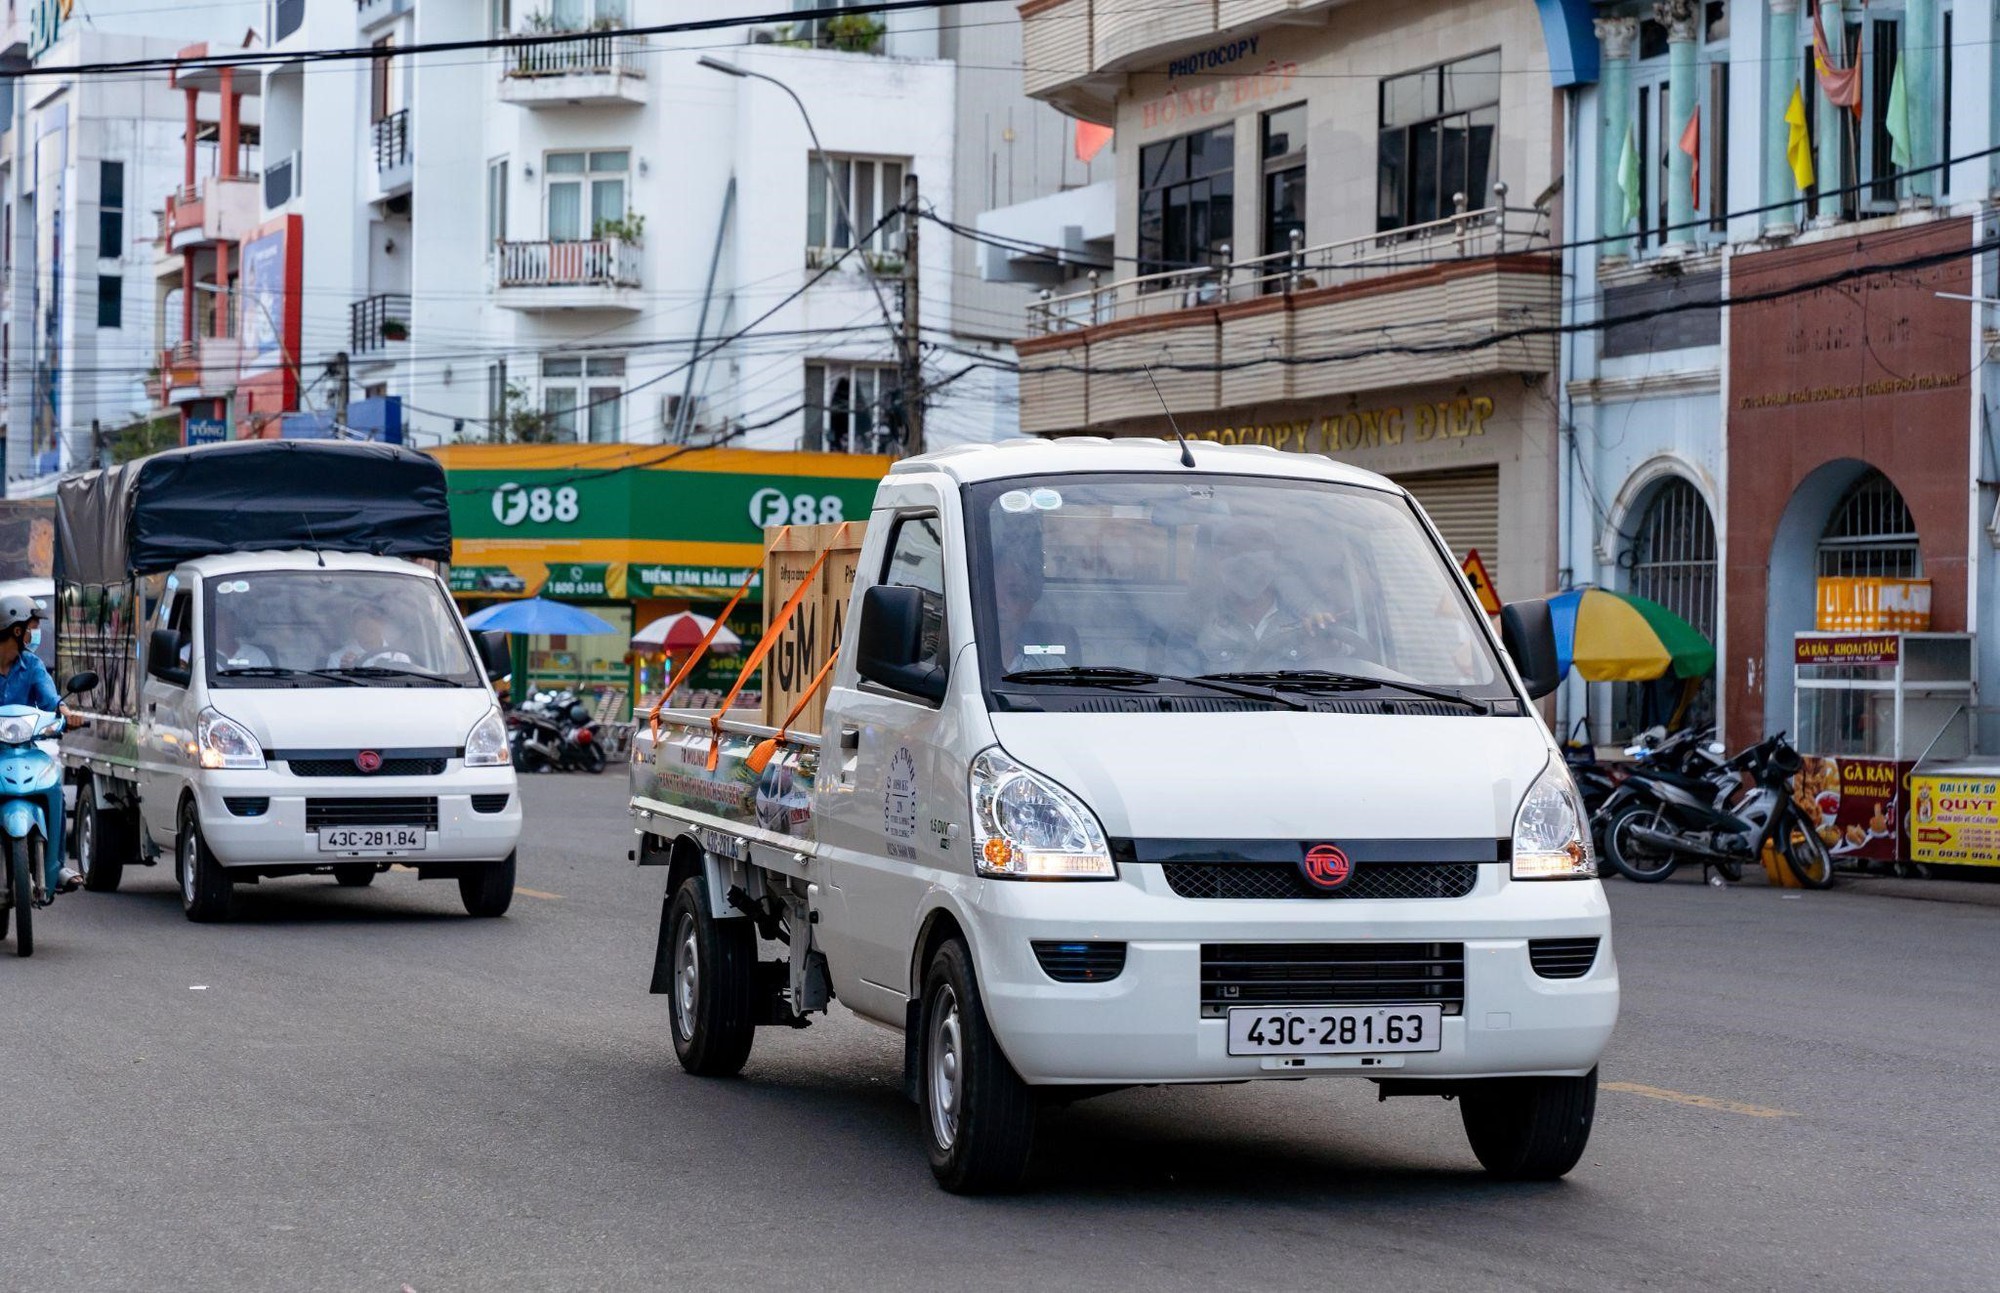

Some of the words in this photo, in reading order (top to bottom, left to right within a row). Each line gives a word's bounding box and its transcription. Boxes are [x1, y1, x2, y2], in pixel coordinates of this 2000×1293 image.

[1168, 36, 1260, 79] PHOTOCOPY
[492, 482, 579, 526] F88
[749, 487, 844, 530] F88
[1799, 641, 1811, 657] GÀ
[1811, 641, 1829, 656] RÁN
[1834, 642, 1861, 656] KHOAI
[1844, 763, 1863, 781] GÀ
[1866, 763, 1894, 783] RÁN
[328, 831, 417, 846] 43C-281.84
[1247, 1014, 1424, 1046] 43C-281.63
